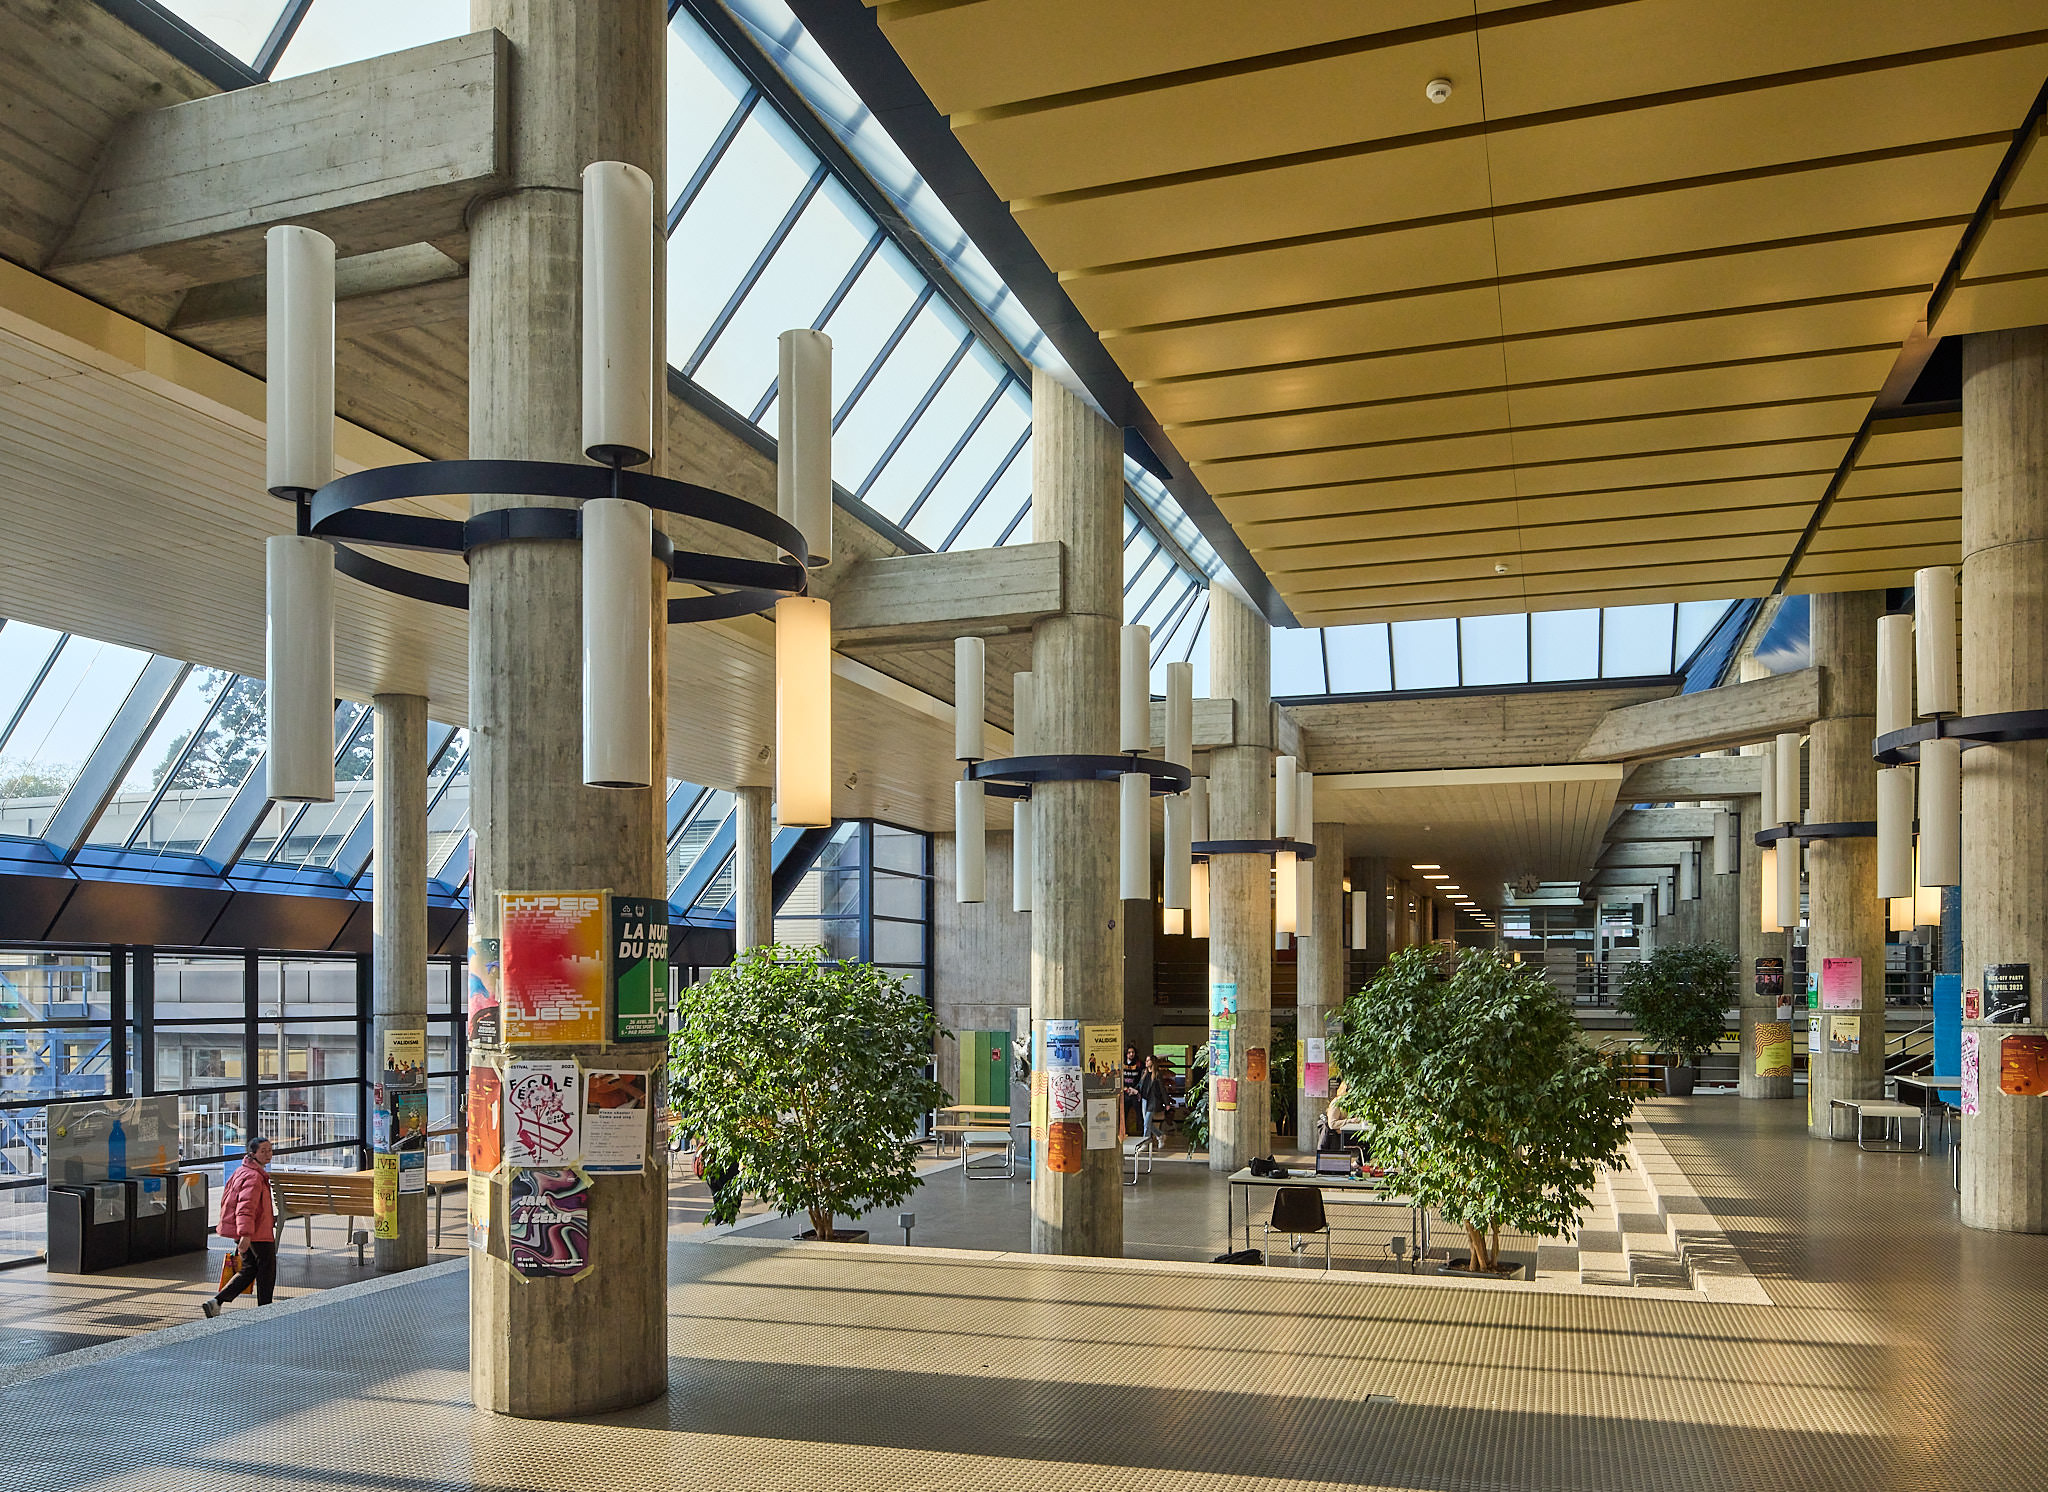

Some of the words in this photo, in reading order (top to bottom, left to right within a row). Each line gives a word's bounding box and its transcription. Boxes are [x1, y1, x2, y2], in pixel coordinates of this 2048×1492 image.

[503, 897, 599, 911] HYPER
[623, 922, 644, 940] LA
[648, 923, 668, 941] NUIT
[618, 941, 643, 959] DU
[646, 942, 668, 960] FOOT
[2009, 983, 2024, 991] 2023
[375, 1158, 397, 1170] IVE
[374, 1189, 396, 1201] ival
[519, 1195, 547, 1207] JAM
[518, 1209, 529, 1224] À
[531, 1210, 572, 1224] ZÉLIG
